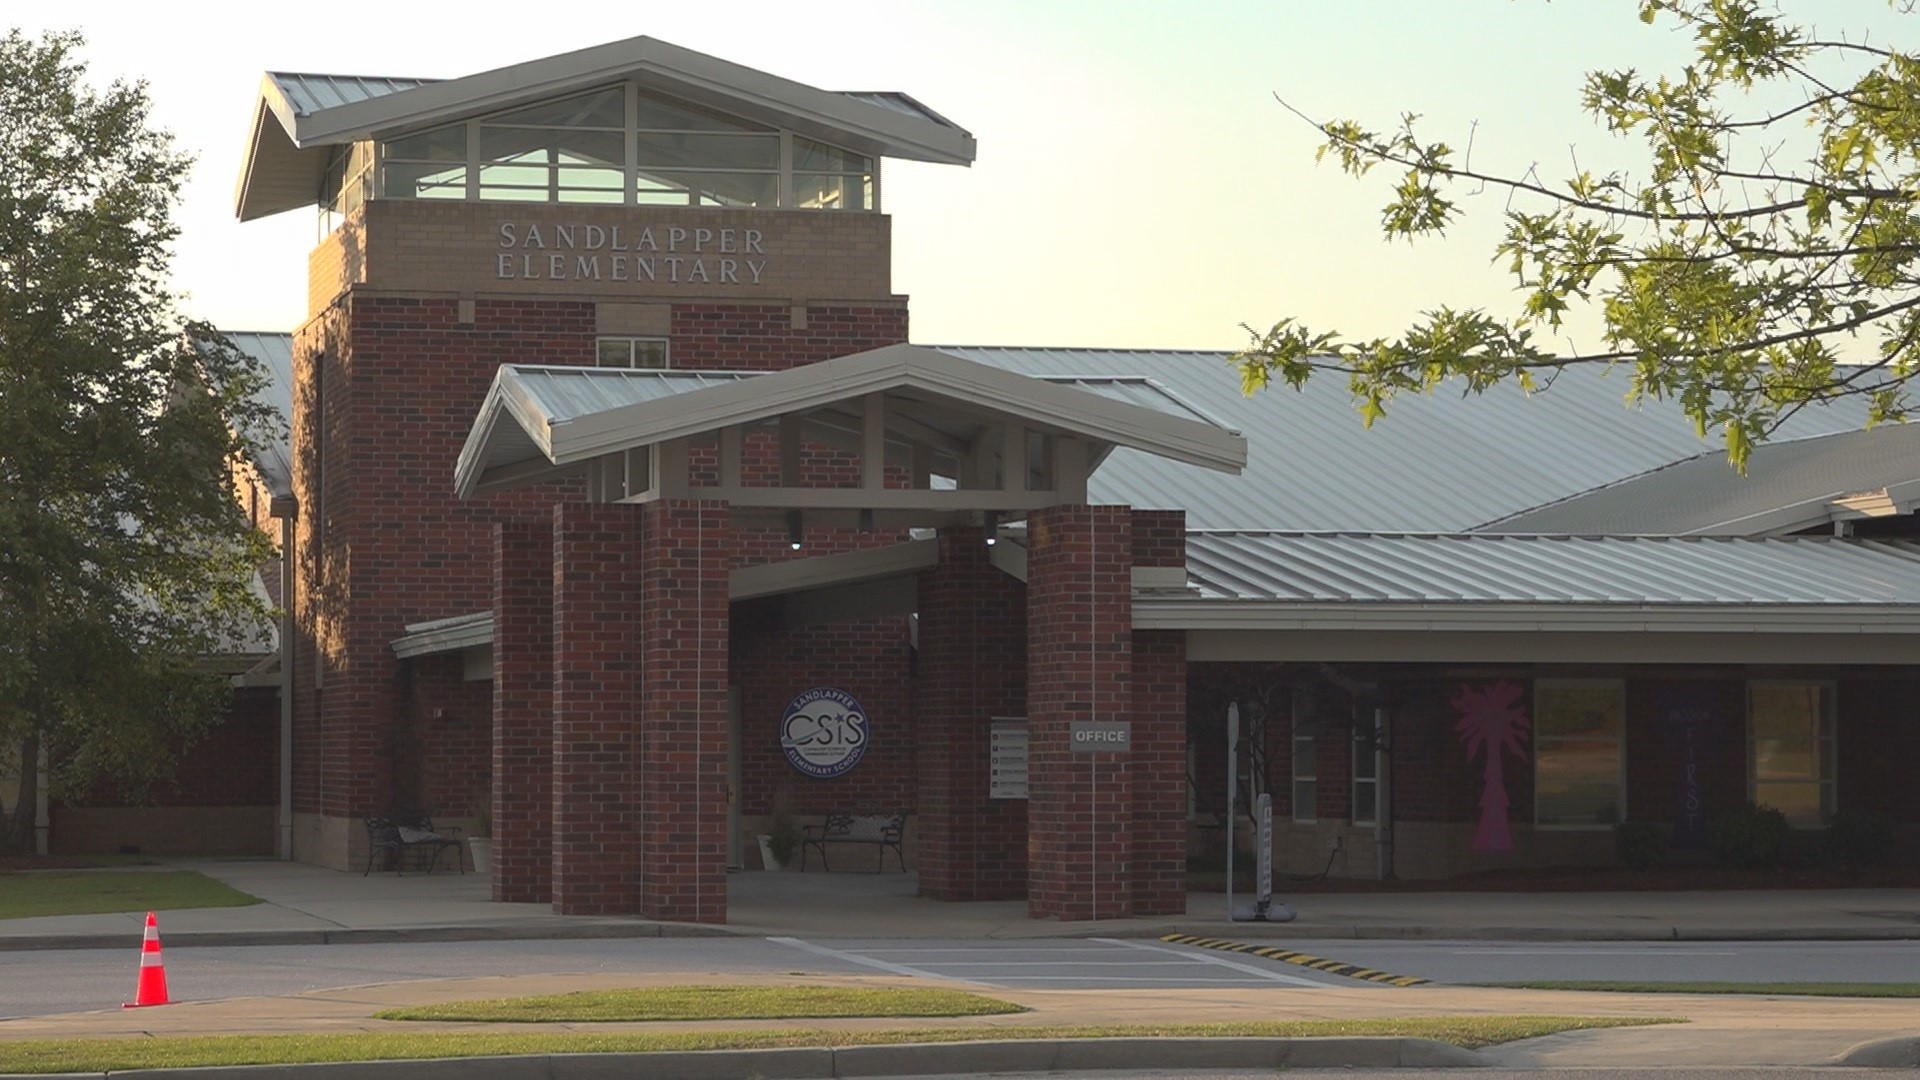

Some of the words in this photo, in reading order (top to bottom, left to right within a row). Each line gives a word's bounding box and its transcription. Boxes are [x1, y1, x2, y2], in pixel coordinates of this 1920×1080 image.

[500, 223, 767, 254] SANDLAPPER
[498, 252, 768, 284] ELEMENTARY
[794, 690, 854, 709] SANDLAPPER
[1076, 730, 1125, 742] OFFICE
[789, 750, 832, 773] ELEMENTARY
[833, 749, 860, 772] SCHOOL
